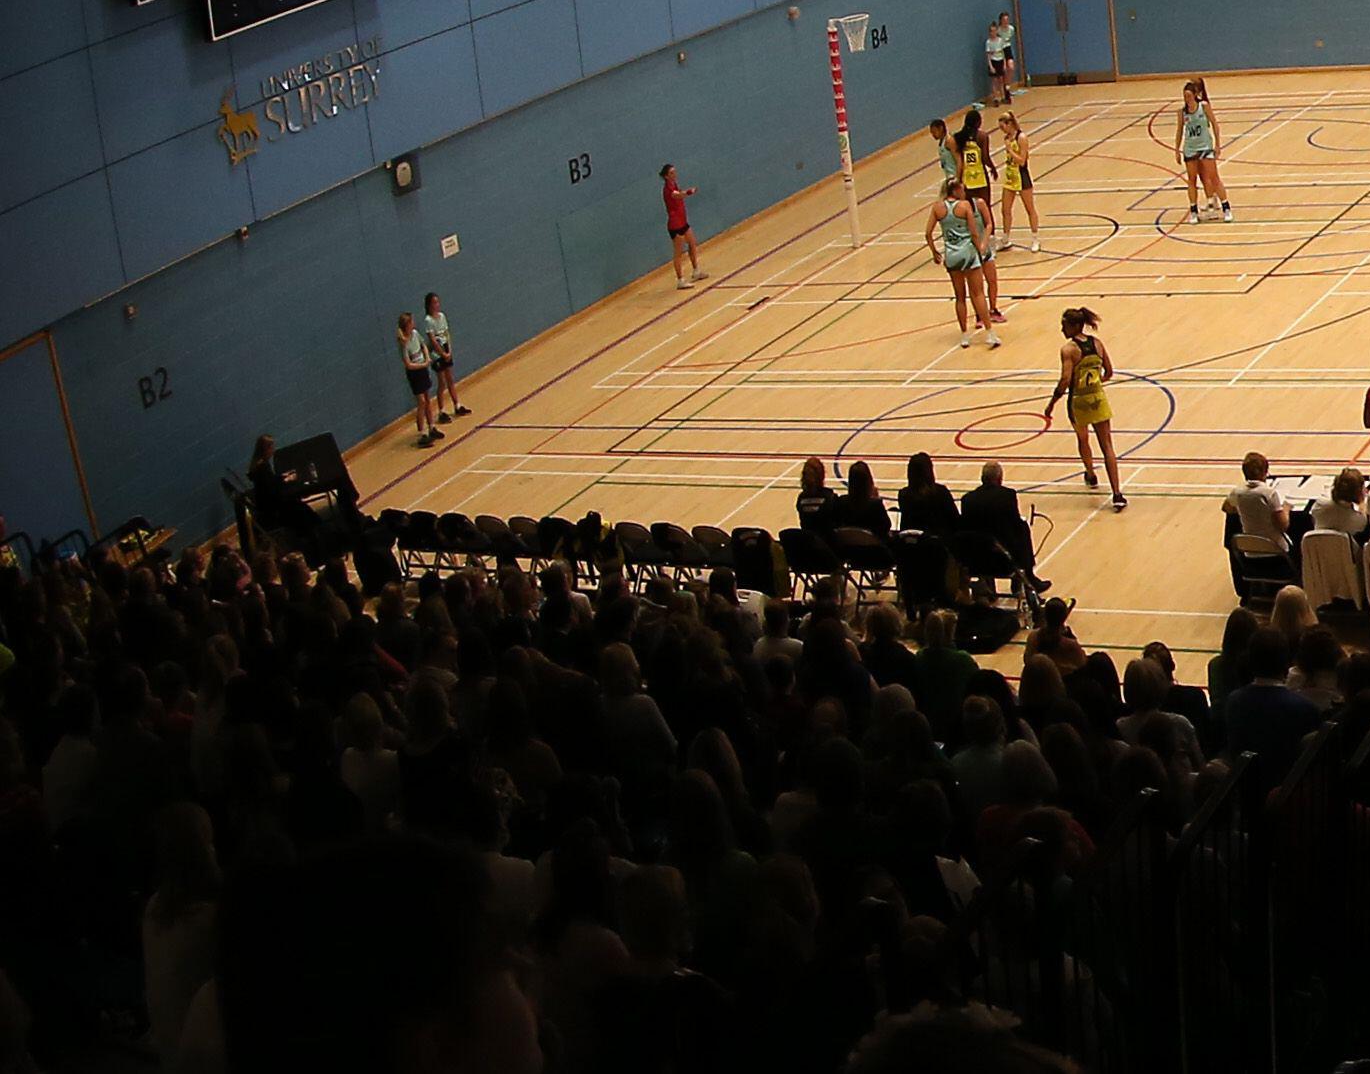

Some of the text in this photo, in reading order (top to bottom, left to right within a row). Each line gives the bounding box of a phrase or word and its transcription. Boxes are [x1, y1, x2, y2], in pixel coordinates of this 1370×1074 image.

[871, 25, 888, 49] B4
[261, 44, 358, 98] UNIVERSTY
[265, 59, 381, 142] SURREY
[568, 153, 592, 184] B3
[139, 367, 172, 409] B2
